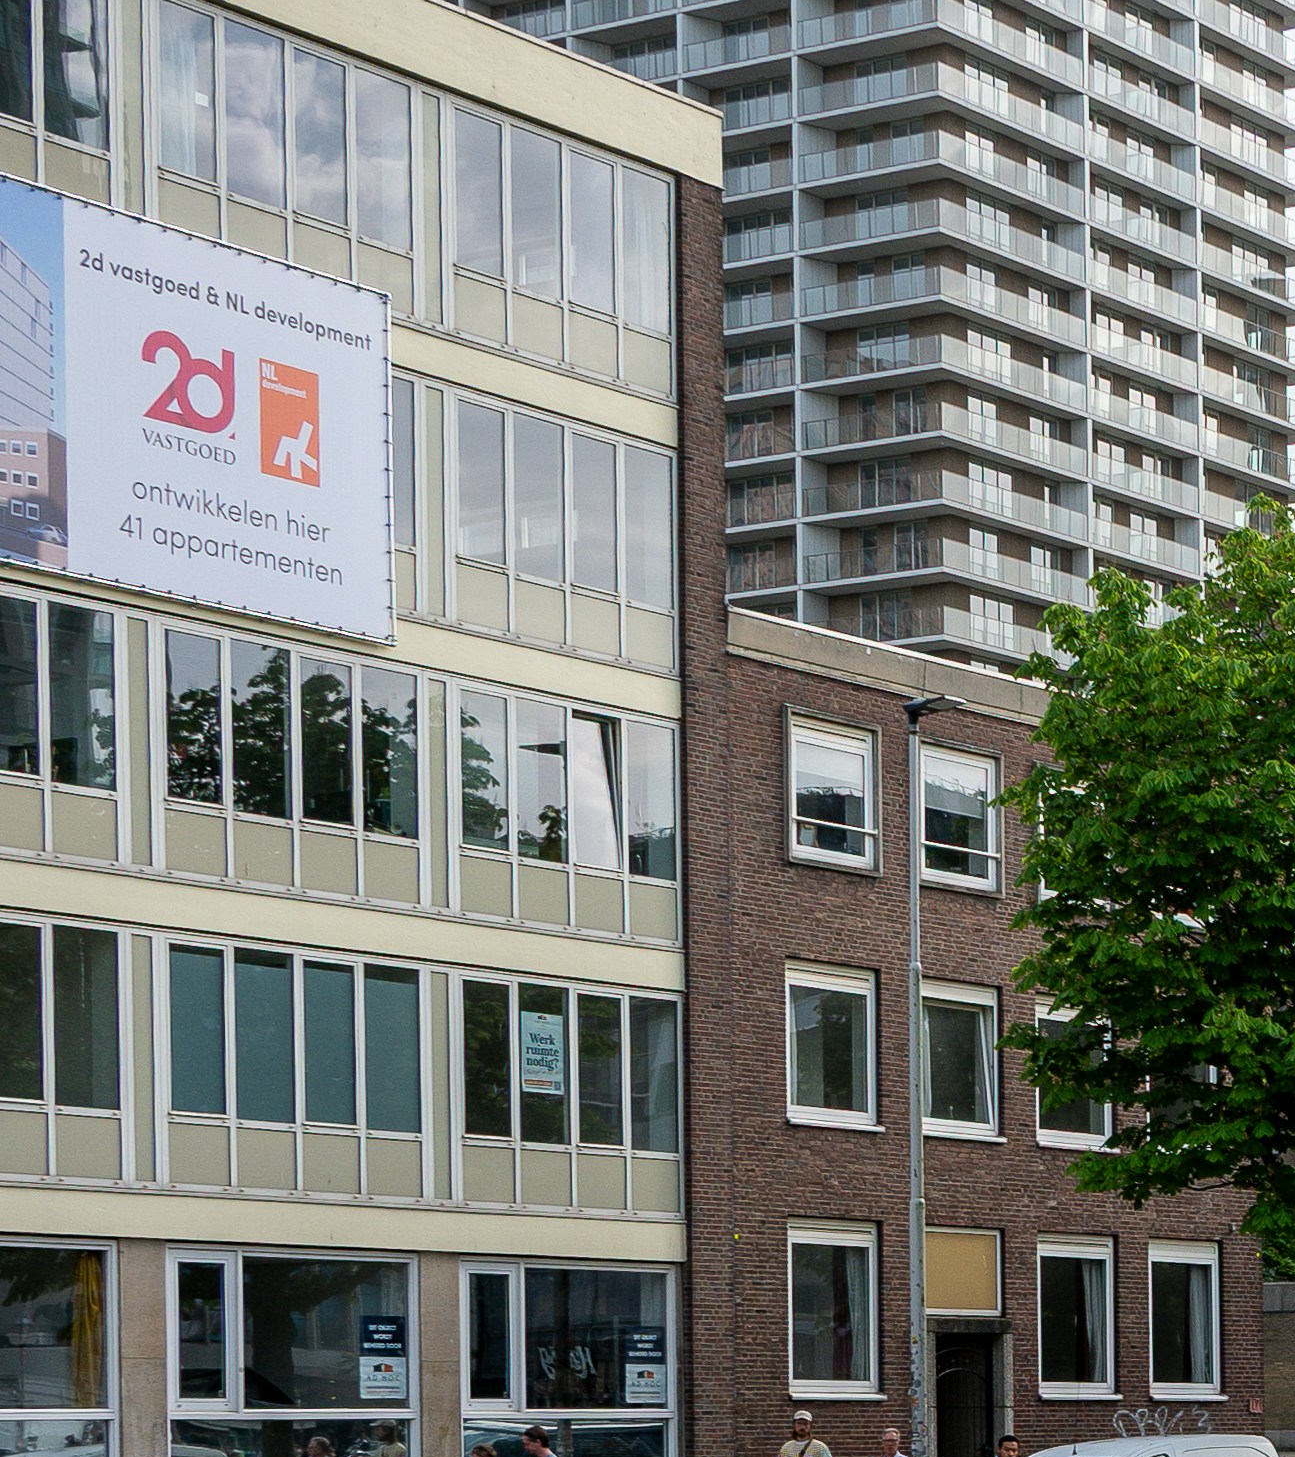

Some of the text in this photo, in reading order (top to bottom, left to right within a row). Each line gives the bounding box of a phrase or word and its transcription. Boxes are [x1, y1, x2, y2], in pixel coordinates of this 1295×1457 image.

[79, 248, 372, 351] 2d vastgoed & NL development
[141, 329, 236, 435] 2d
[261, 361, 279, 382] NL
[141, 427, 237, 466] VASTGOED
[132, 481, 331, 542] ontwikkelen hier
[118, 514, 343, 586] 41 appartementen
[525, 1045, 560, 1058] ruimte
[529, 1032, 556, 1046] Werk
[526, 1056, 560, 1072] nodig?
